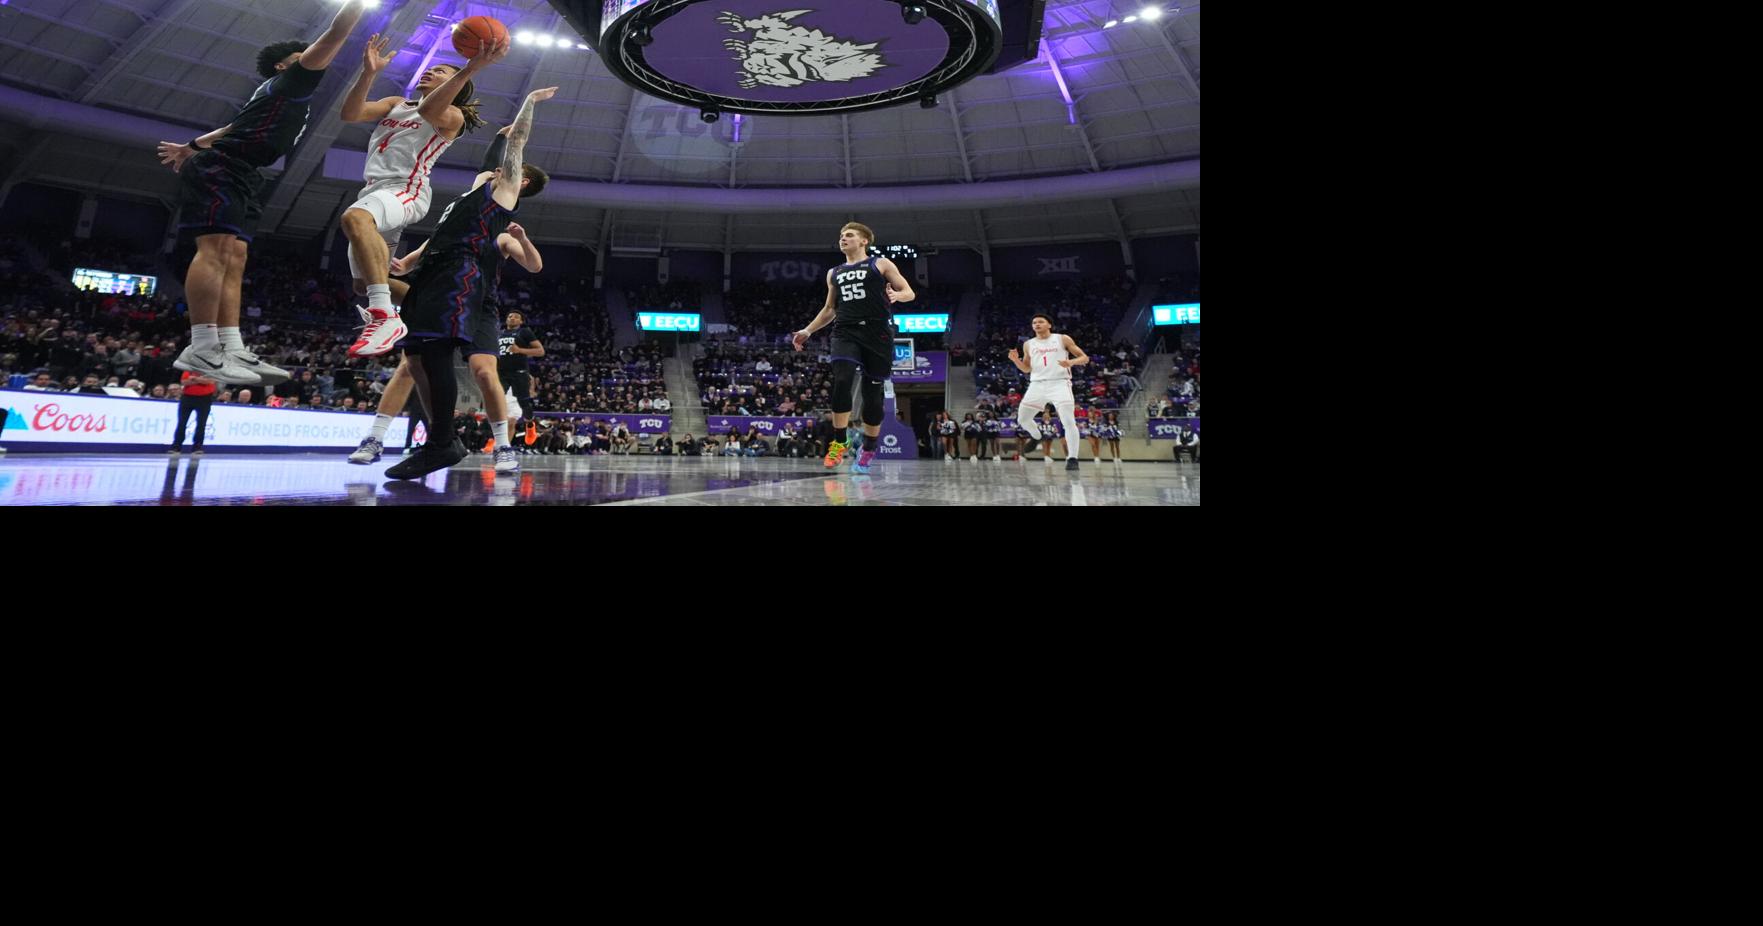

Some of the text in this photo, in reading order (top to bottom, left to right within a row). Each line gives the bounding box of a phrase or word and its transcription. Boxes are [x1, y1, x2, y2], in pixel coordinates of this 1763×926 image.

[760, 260, 821, 282] TCU
[837, 270, 868, 284] TCU
[841, 283, 866, 301] 55
[655, 316, 699, 329] EECU
[498, 337, 515, 346] TCU
[1042, 355, 1048, 367] 1
[32, 403, 171, 434] Coors LIGHT
[639, 418, 663, 429] TCU
[228, 421, 291, 437] HORNED
[295, 424, 329, 438] FROG
[750, 420, 774, 431] TCU
[1155, 424, 1182, 435] TCU
[880, 446, 902, 454] Frost
